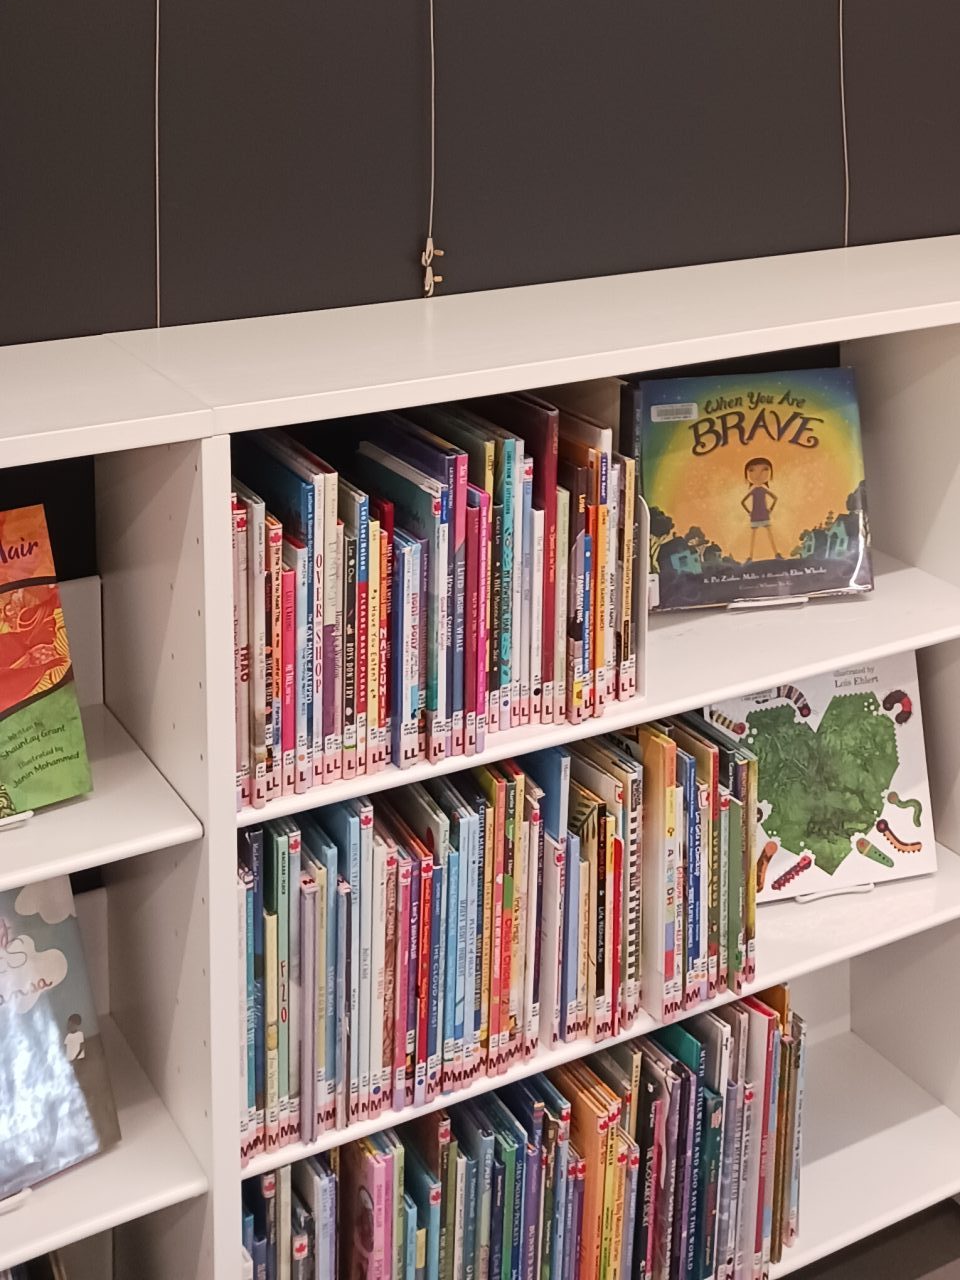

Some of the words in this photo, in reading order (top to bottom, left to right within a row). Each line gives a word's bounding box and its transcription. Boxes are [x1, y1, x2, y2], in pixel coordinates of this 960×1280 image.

[704, 397, 743, 413] When
[747, 392, 774, 410] You
[778, 390, 806, 408] Are
[688, 410, 825, 457] BRAVE
[457, 568, 465, 588] LIVED
[457, 592, 465, 613] INSIDE
[457, 627, 465, 652] WHALE
[346, 642, 354, 660] BOYS
[240, 645, 249, 682] THAO
[599, 695, 604, 704] L
[491, 714, 497, 723] L
[522, 708, 529, 716] L
[546, 706, 553, 715] L
[1, 734, 40, 760] Shauntay
[41, 724, 65, 738] Grant
[456, 736, 463, 747] L
[13, 770, 34, 788] Janin
[34, 751, 79, 773] Mohammed
[315, 765, 323, 775] L
[334, 759, 340, 769] L
[359, 756, 366, 767] L
[287, 774, 295, 786] L
[242, 788, 250, 798] L
[668, 849, 674, 857] A
[504, 918, 512, 952] Chicka
[502, 955, 511, 990] Chicka
[698, 1050, 706, 1077] MUTH
[695, 1086, 703, 1143] STILLWATER
